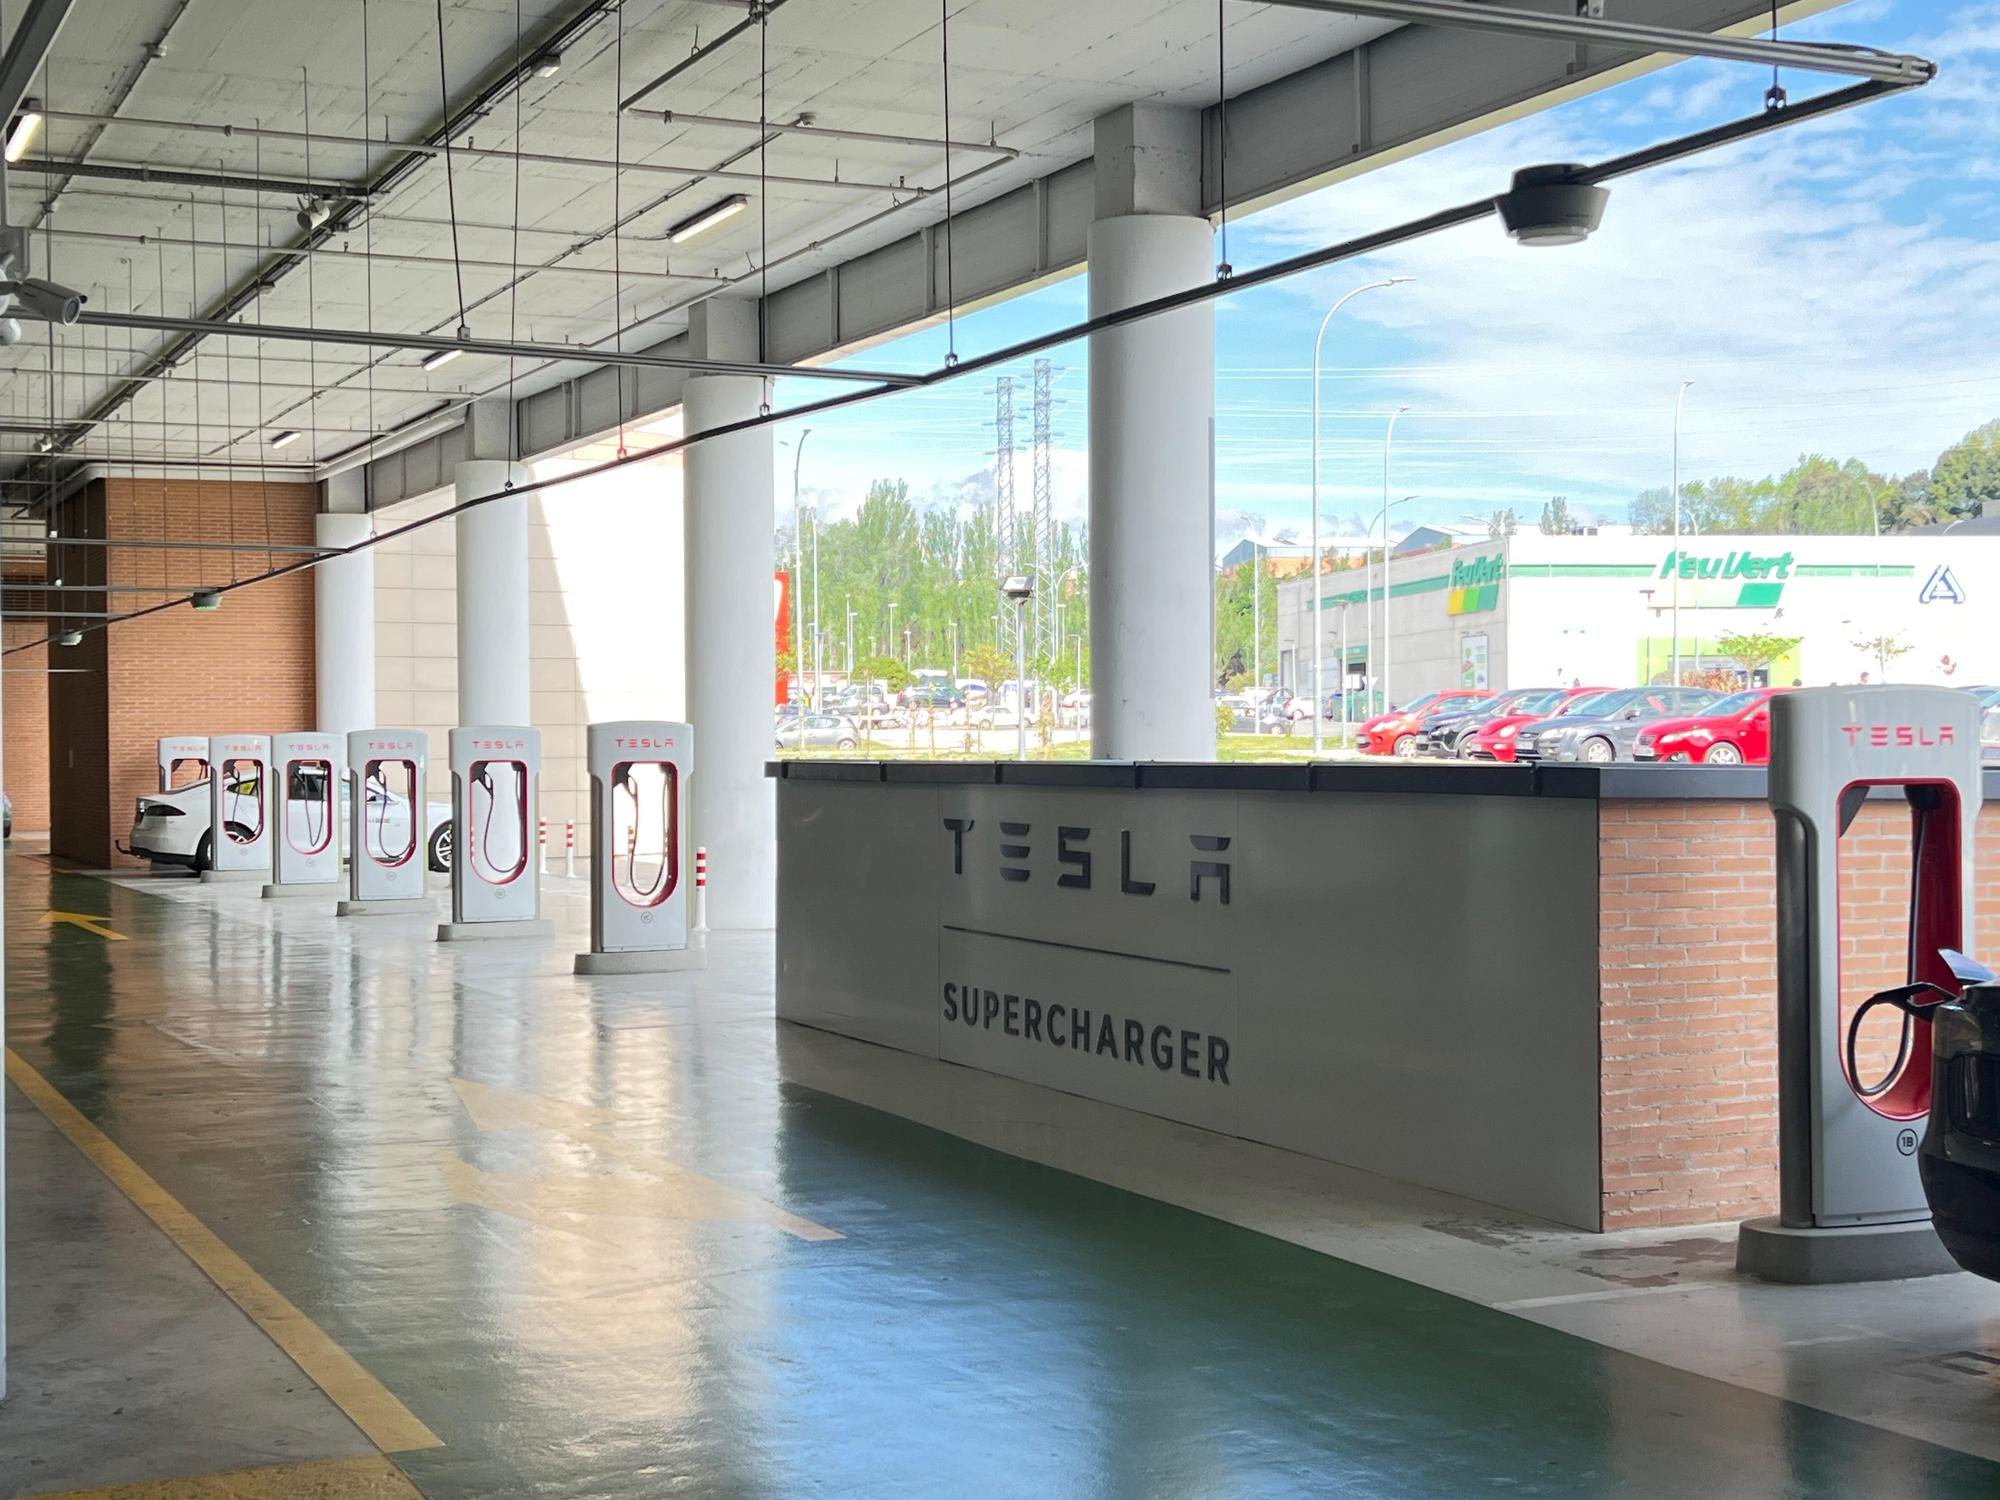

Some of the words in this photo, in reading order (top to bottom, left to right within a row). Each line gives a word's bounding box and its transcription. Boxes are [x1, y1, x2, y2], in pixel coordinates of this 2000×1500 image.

[1840, 726, 1953, 746] TESLA
[368, 742, 413, 750] TESLA
[472, 741, 524, 749] TESLA
[615, 738, 674, 748] TESLA
[943, 817, 1231, 905] TESLA
[943, 982, 1231, 1085] SUPERCHARGER
[1902, 1137, 1914, 1147] 1B
